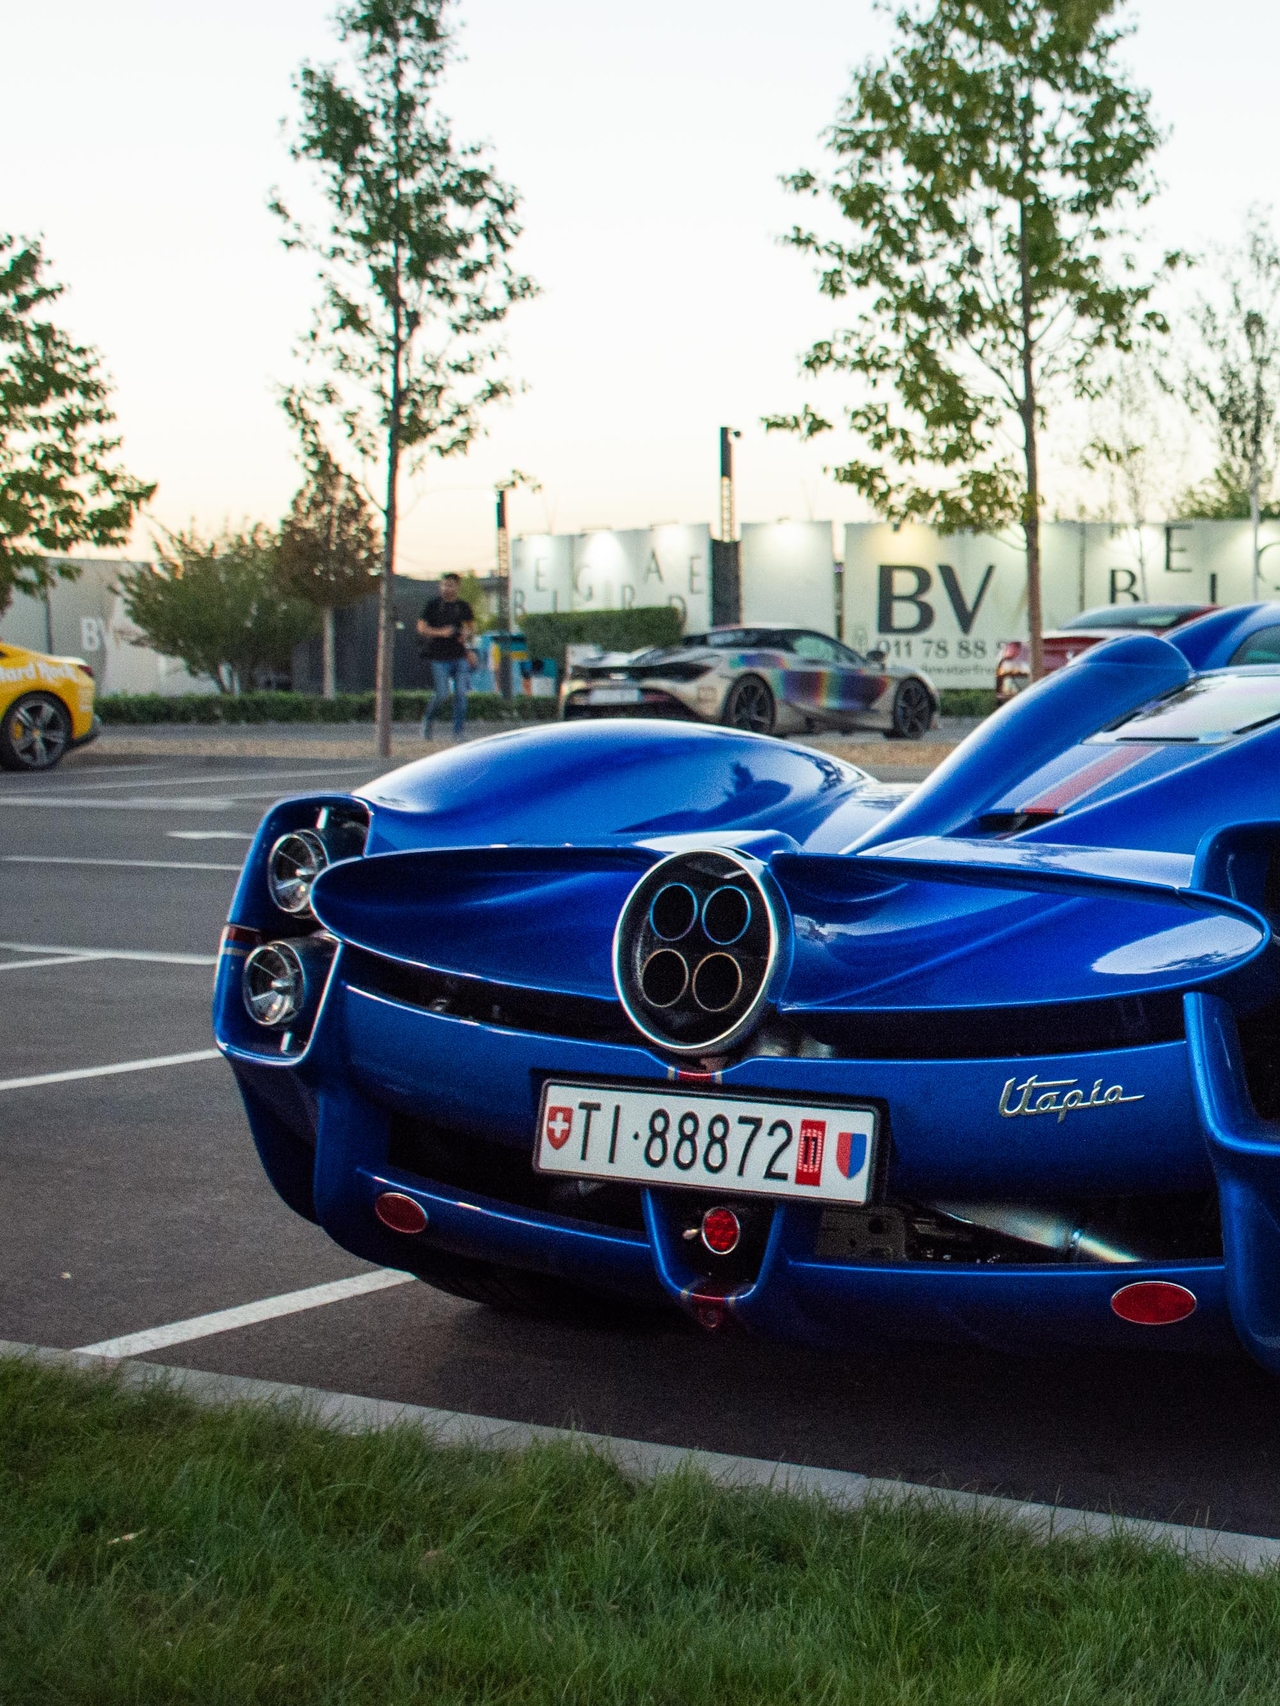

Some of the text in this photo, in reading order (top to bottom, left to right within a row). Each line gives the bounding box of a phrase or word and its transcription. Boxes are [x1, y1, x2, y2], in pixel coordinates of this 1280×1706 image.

[877, 564, 996, 635] BV
[922, 638, 950, 660] 78
[957, 638, 987, 660] 88
[999, 1074, 1145, 1123] Utopia
